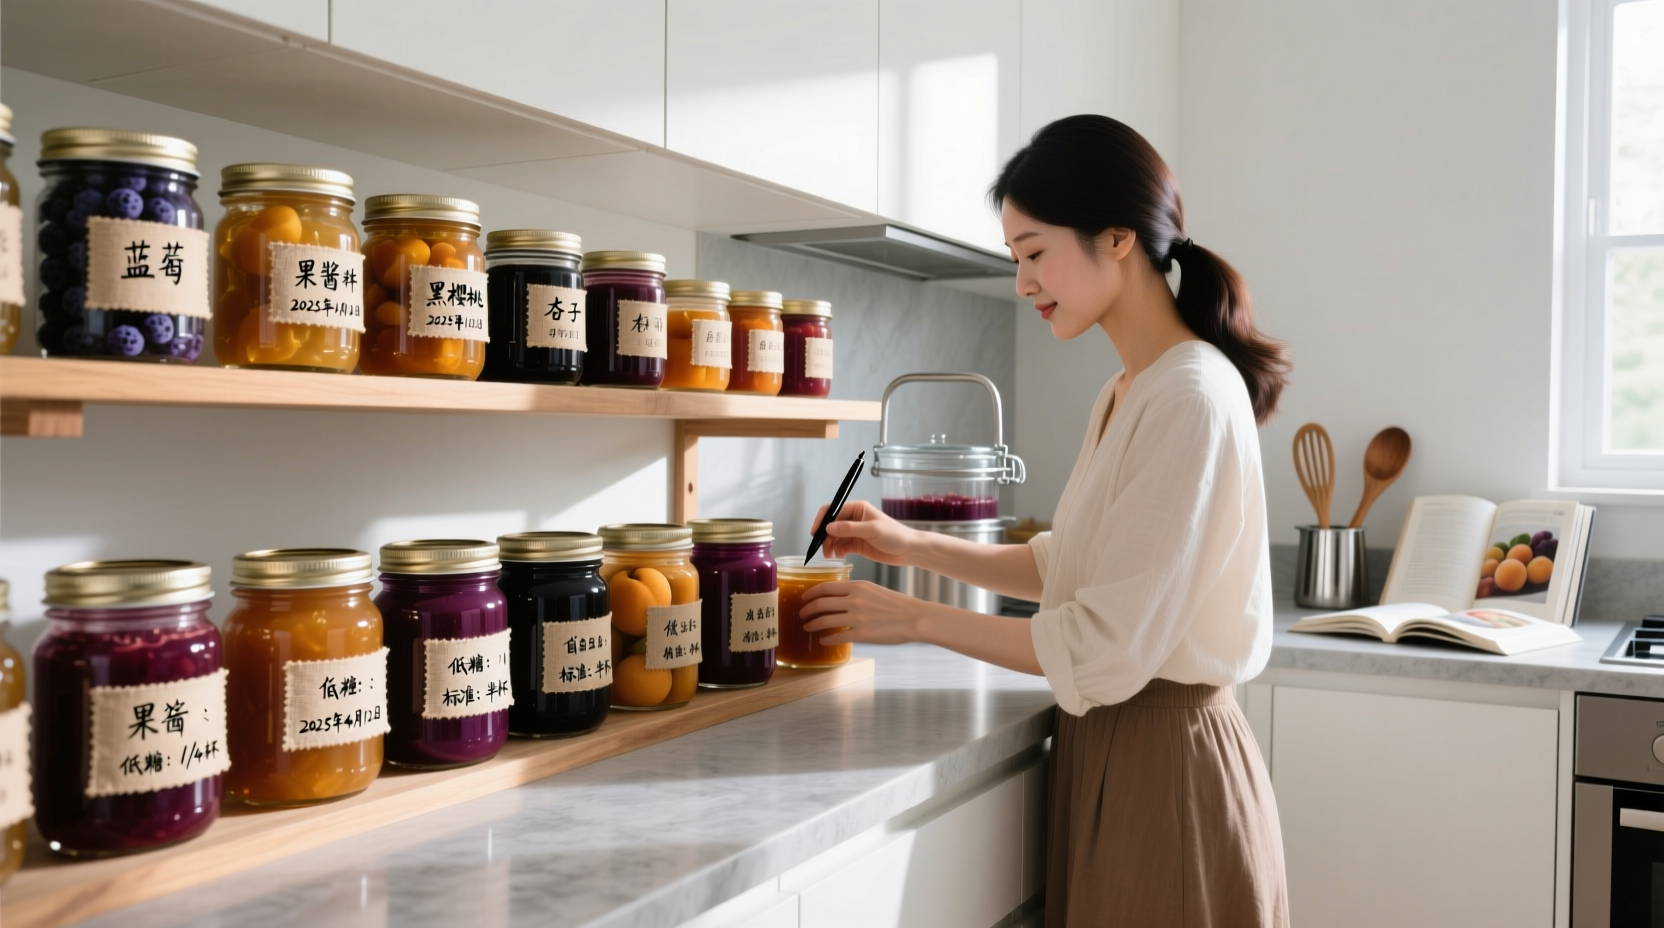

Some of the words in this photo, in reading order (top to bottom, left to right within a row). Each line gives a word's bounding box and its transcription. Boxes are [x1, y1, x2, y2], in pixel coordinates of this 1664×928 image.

[121, 240, 184, 285] 蓝莓
[299, 705, 380, 733] 2025年4月12日
